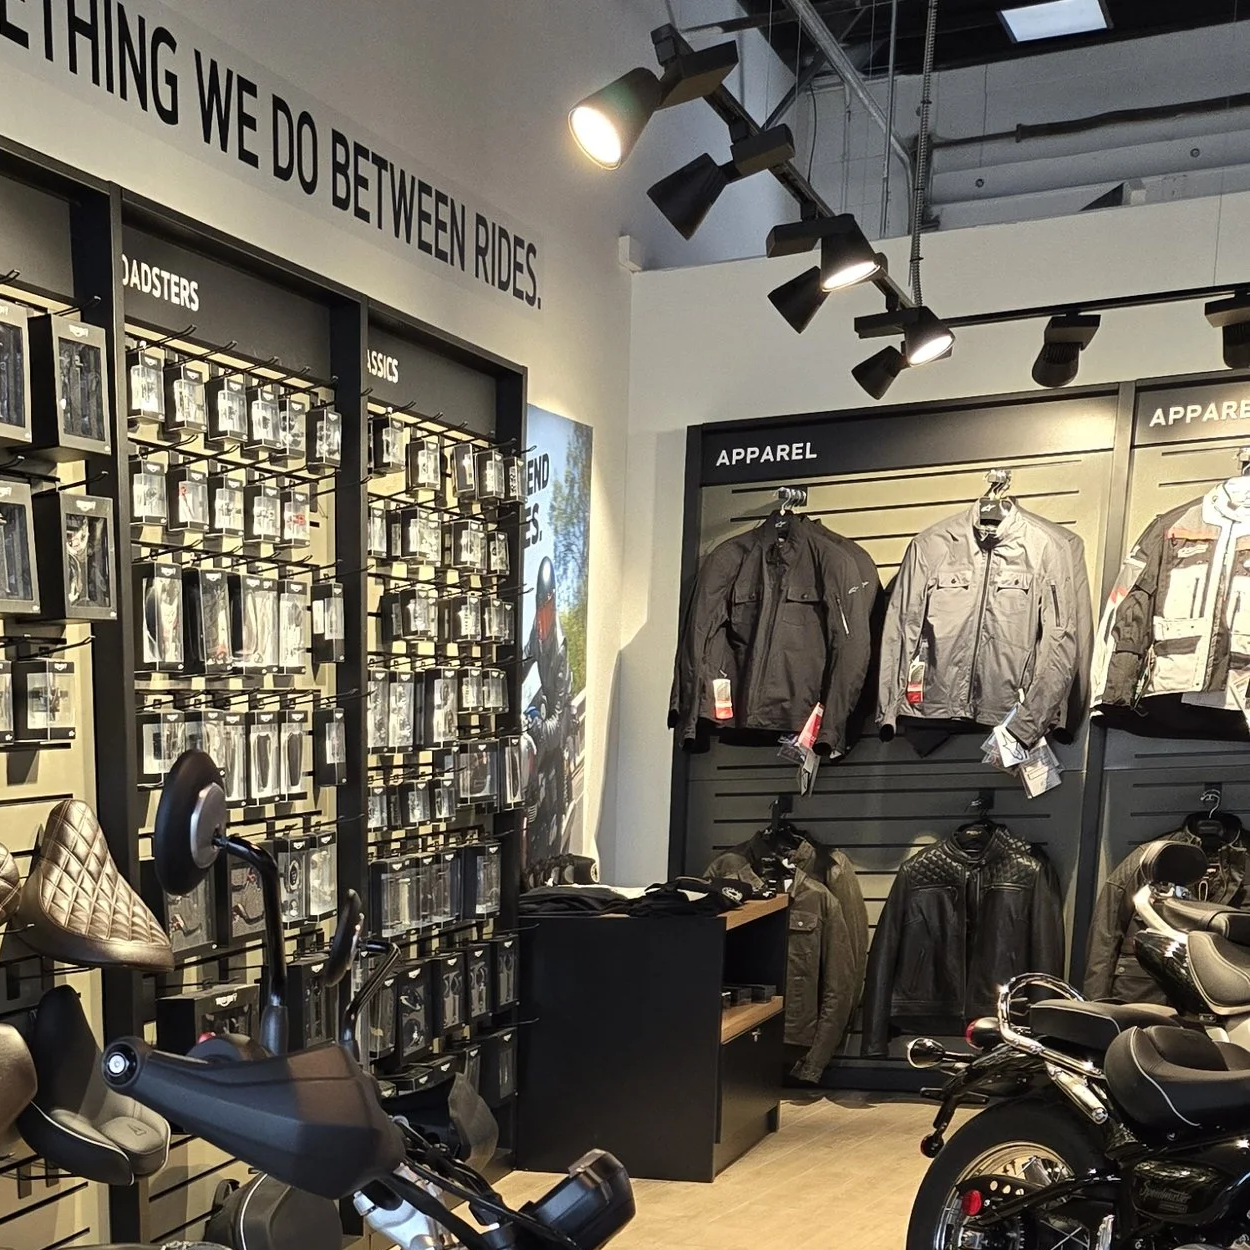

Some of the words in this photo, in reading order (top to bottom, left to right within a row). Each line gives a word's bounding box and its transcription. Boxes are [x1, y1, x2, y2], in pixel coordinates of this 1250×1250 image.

[194, 48, 259, 169] WE
[272, 93, 318, 195] DO
[331, 128, 465, 272] BETWEEN
[475, 212, 542, 310] RIDES.
[122, 254, 199, 312] OADSTERS
[1149, 399, 1250, 427] APPARE
[527, 453, 550, 496] END
[715, 441, 817, 467] APPAREL
[521, 503, 543, 546] ES.
